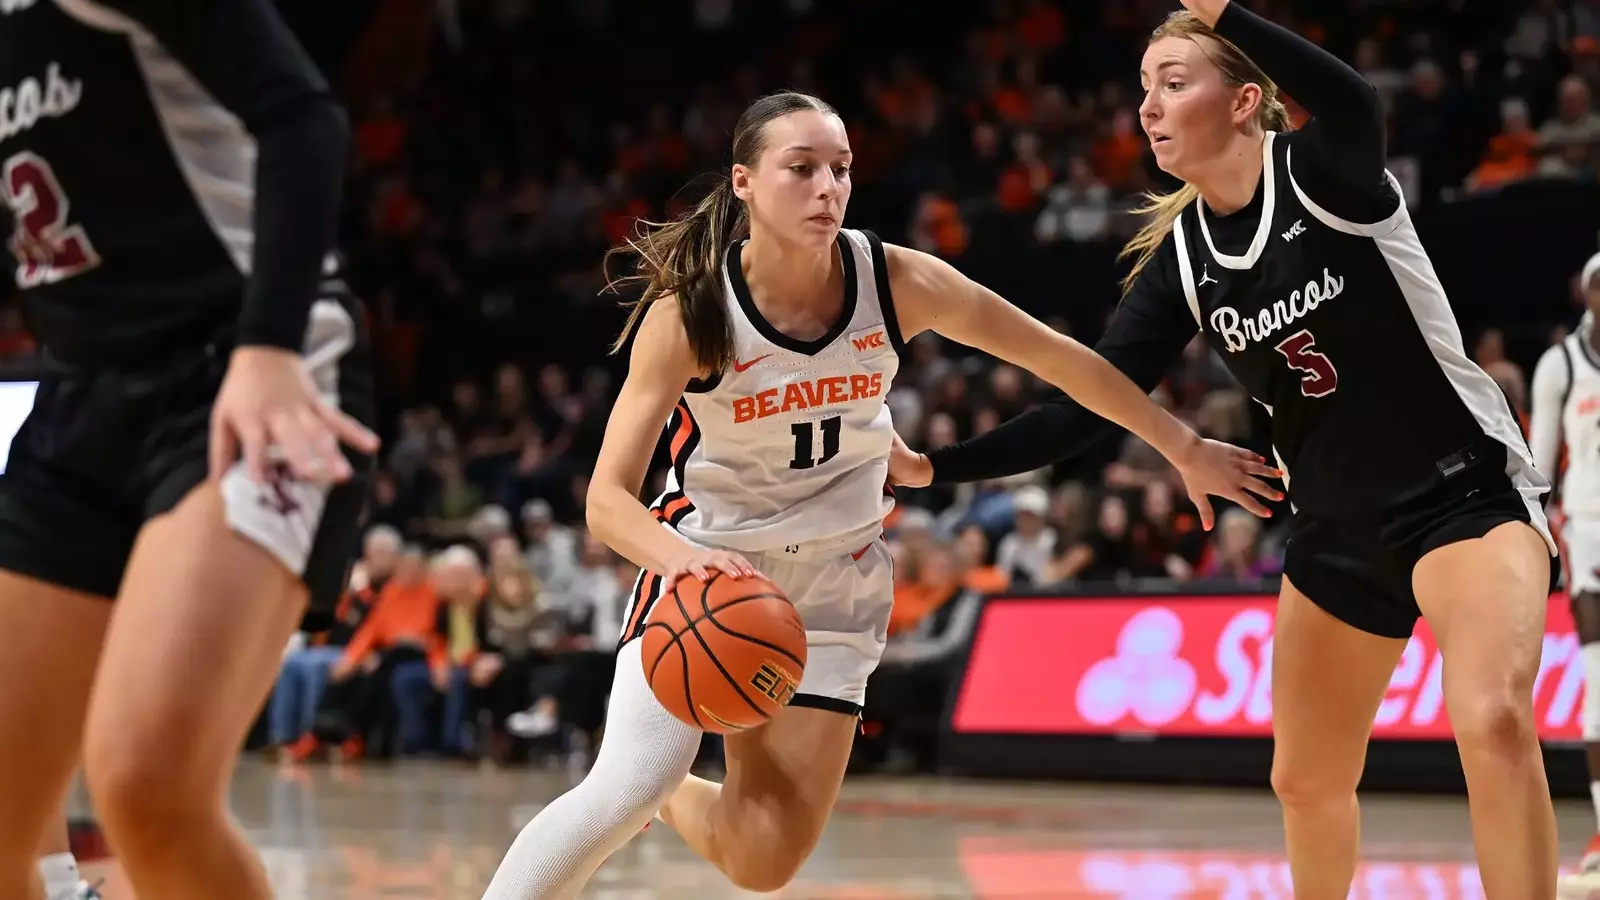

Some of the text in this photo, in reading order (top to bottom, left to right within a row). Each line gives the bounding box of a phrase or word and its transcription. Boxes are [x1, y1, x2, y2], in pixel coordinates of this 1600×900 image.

[1281, 219, 1307, 242] WCC
[1210, 268, 1344, 353] Broncos
[852, 331, 885, 352] WCC
[1274, 329, 1337, 398] 5
[732, 373, 883, 423] BEAVERS
[789, 415, 841, 469] 11
